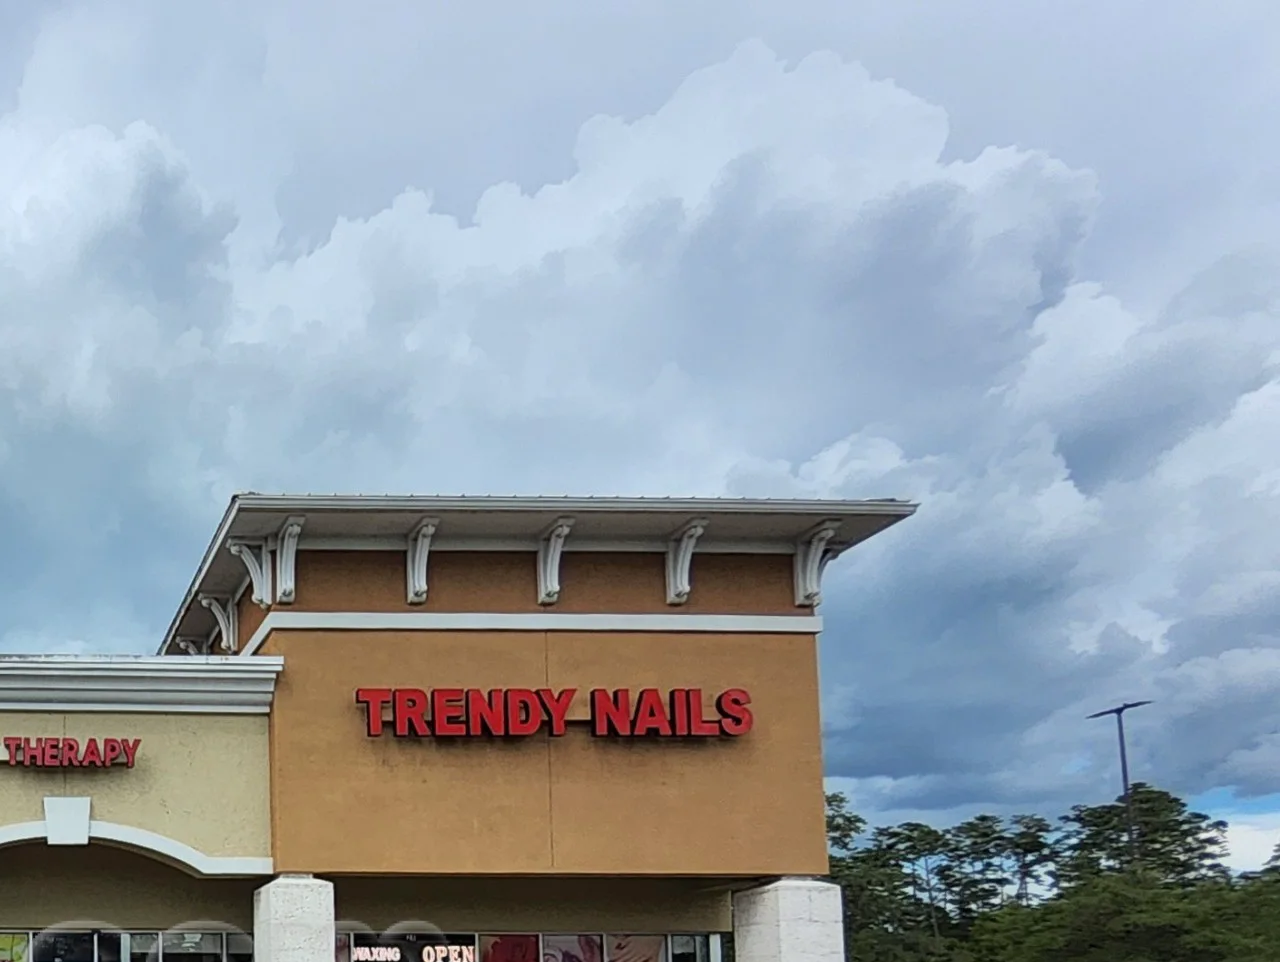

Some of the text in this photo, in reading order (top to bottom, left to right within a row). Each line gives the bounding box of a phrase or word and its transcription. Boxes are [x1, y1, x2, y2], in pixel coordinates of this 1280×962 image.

[356, 688, 753, 737] TRENDY NAILS
[3, 736, 141, 768] THERAPY
[352, 946, 401, 962] WAXING
